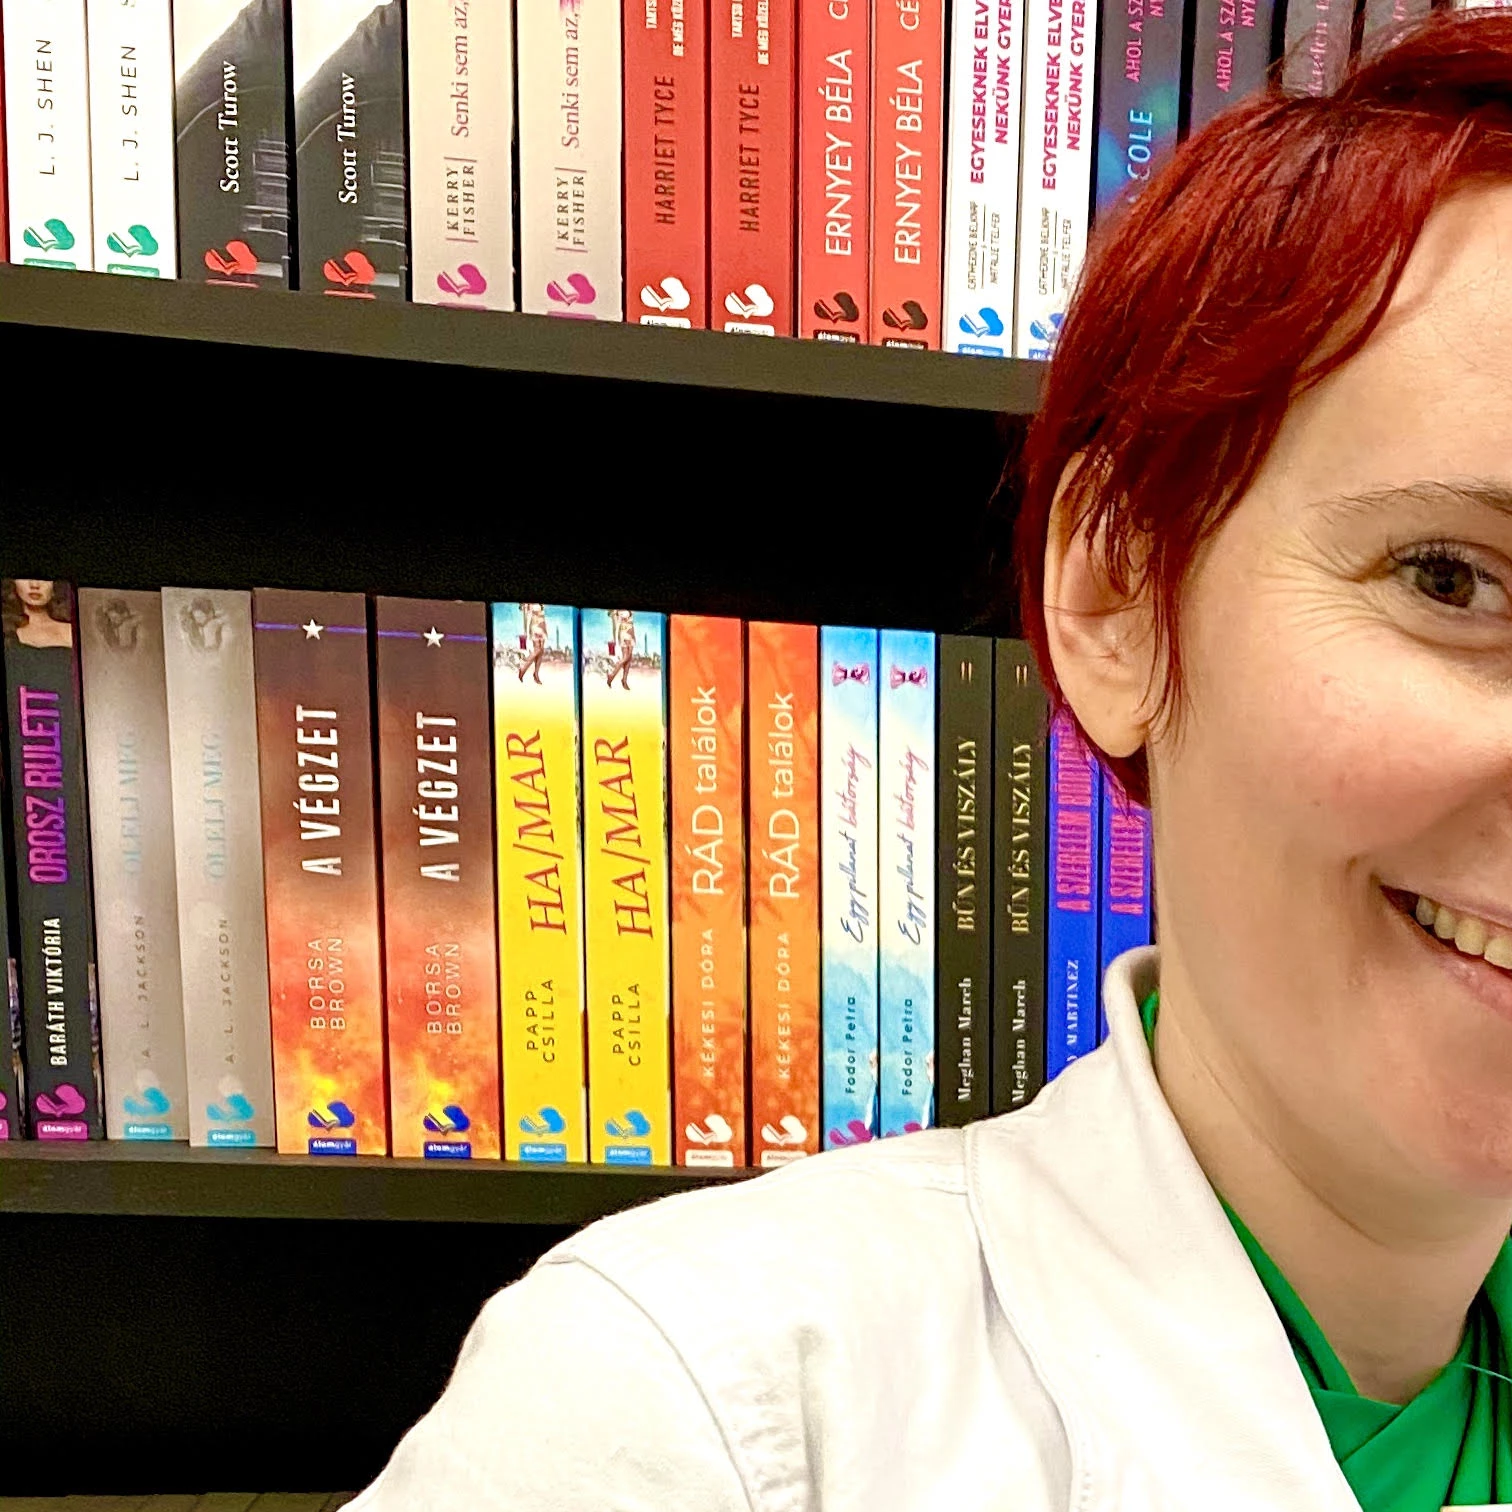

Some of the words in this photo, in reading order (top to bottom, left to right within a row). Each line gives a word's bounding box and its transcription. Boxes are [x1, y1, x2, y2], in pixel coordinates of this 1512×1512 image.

[454, 36, 468, 76] sem
[567, 12, 580, 40] az,
[1125, 37, 1143, 83] AHOL
[1130, 20, 1142, 33] A
[218, 60, 238, 130] Turow
[566, 50, 579, 86] sem
[654, 76, 674, 126] TYCE
[823, 48, 853, 124] BÉLA
[892, 59, 923, 134] BÉLA
[992, 54, 1010, 144] NEKÜNK
[337, 72, 357, 141] Turow
[451, 82, 469, 138] Senki
[562, 92, 579, 148] Senki
[739, 83, 760, 136] TYCE
[971, 46, 988, 184] EGYESEKNEK
[220, 135, 240, 193] Scott
[338, 146, 359, 203] Scott
[446, 168, 459, 231] KERRY
[462, 165, 475, 236] FISHER
[655, 134, 675, 224] HARRIET
[740, 143, 761, 233] HARRIET
[825, 131, 853, 256] ERNYEY
[557, 176, 569, 240] KERRY
[573, 176, 585, 246] FISHER
[895, 141, 922, 265] ERNYEY
[293, 705, 341, 841] VÉGZET
[690, 685, 718, 795] találok
[768, 691, 796, 799] találok
[412, 711, 459, 846] VÉGZET
[301, 856, 343, 876] A
[505, 730, 568, 935] HA/MAR
[594, 736, 654, 939] HA/MAR
[685, 805, 724, 895] RÁD
[761, 809, 801, 898] RÁD
[420, 863, 460, 882] A
[40, 917, 63, 995] VIKTÓRIA
[308, 938, 326, 1029] BORSA
[329, 938, 346, 1030] BROWN
[425, 943, 443, 1034] BORSA
[446, 943, 463, 1035] BROWN
[45, 1001, 67, 1066] BARÁTH
[525, 990, 538, 1051] PAPP
[541, 979, 555, 1064] CSILLA
[612, 994, 624, 1054] PAPP
[627, 983, 641, 1067] CSILLA
[1066, 959, 1079, 1044] MARTINEZ
